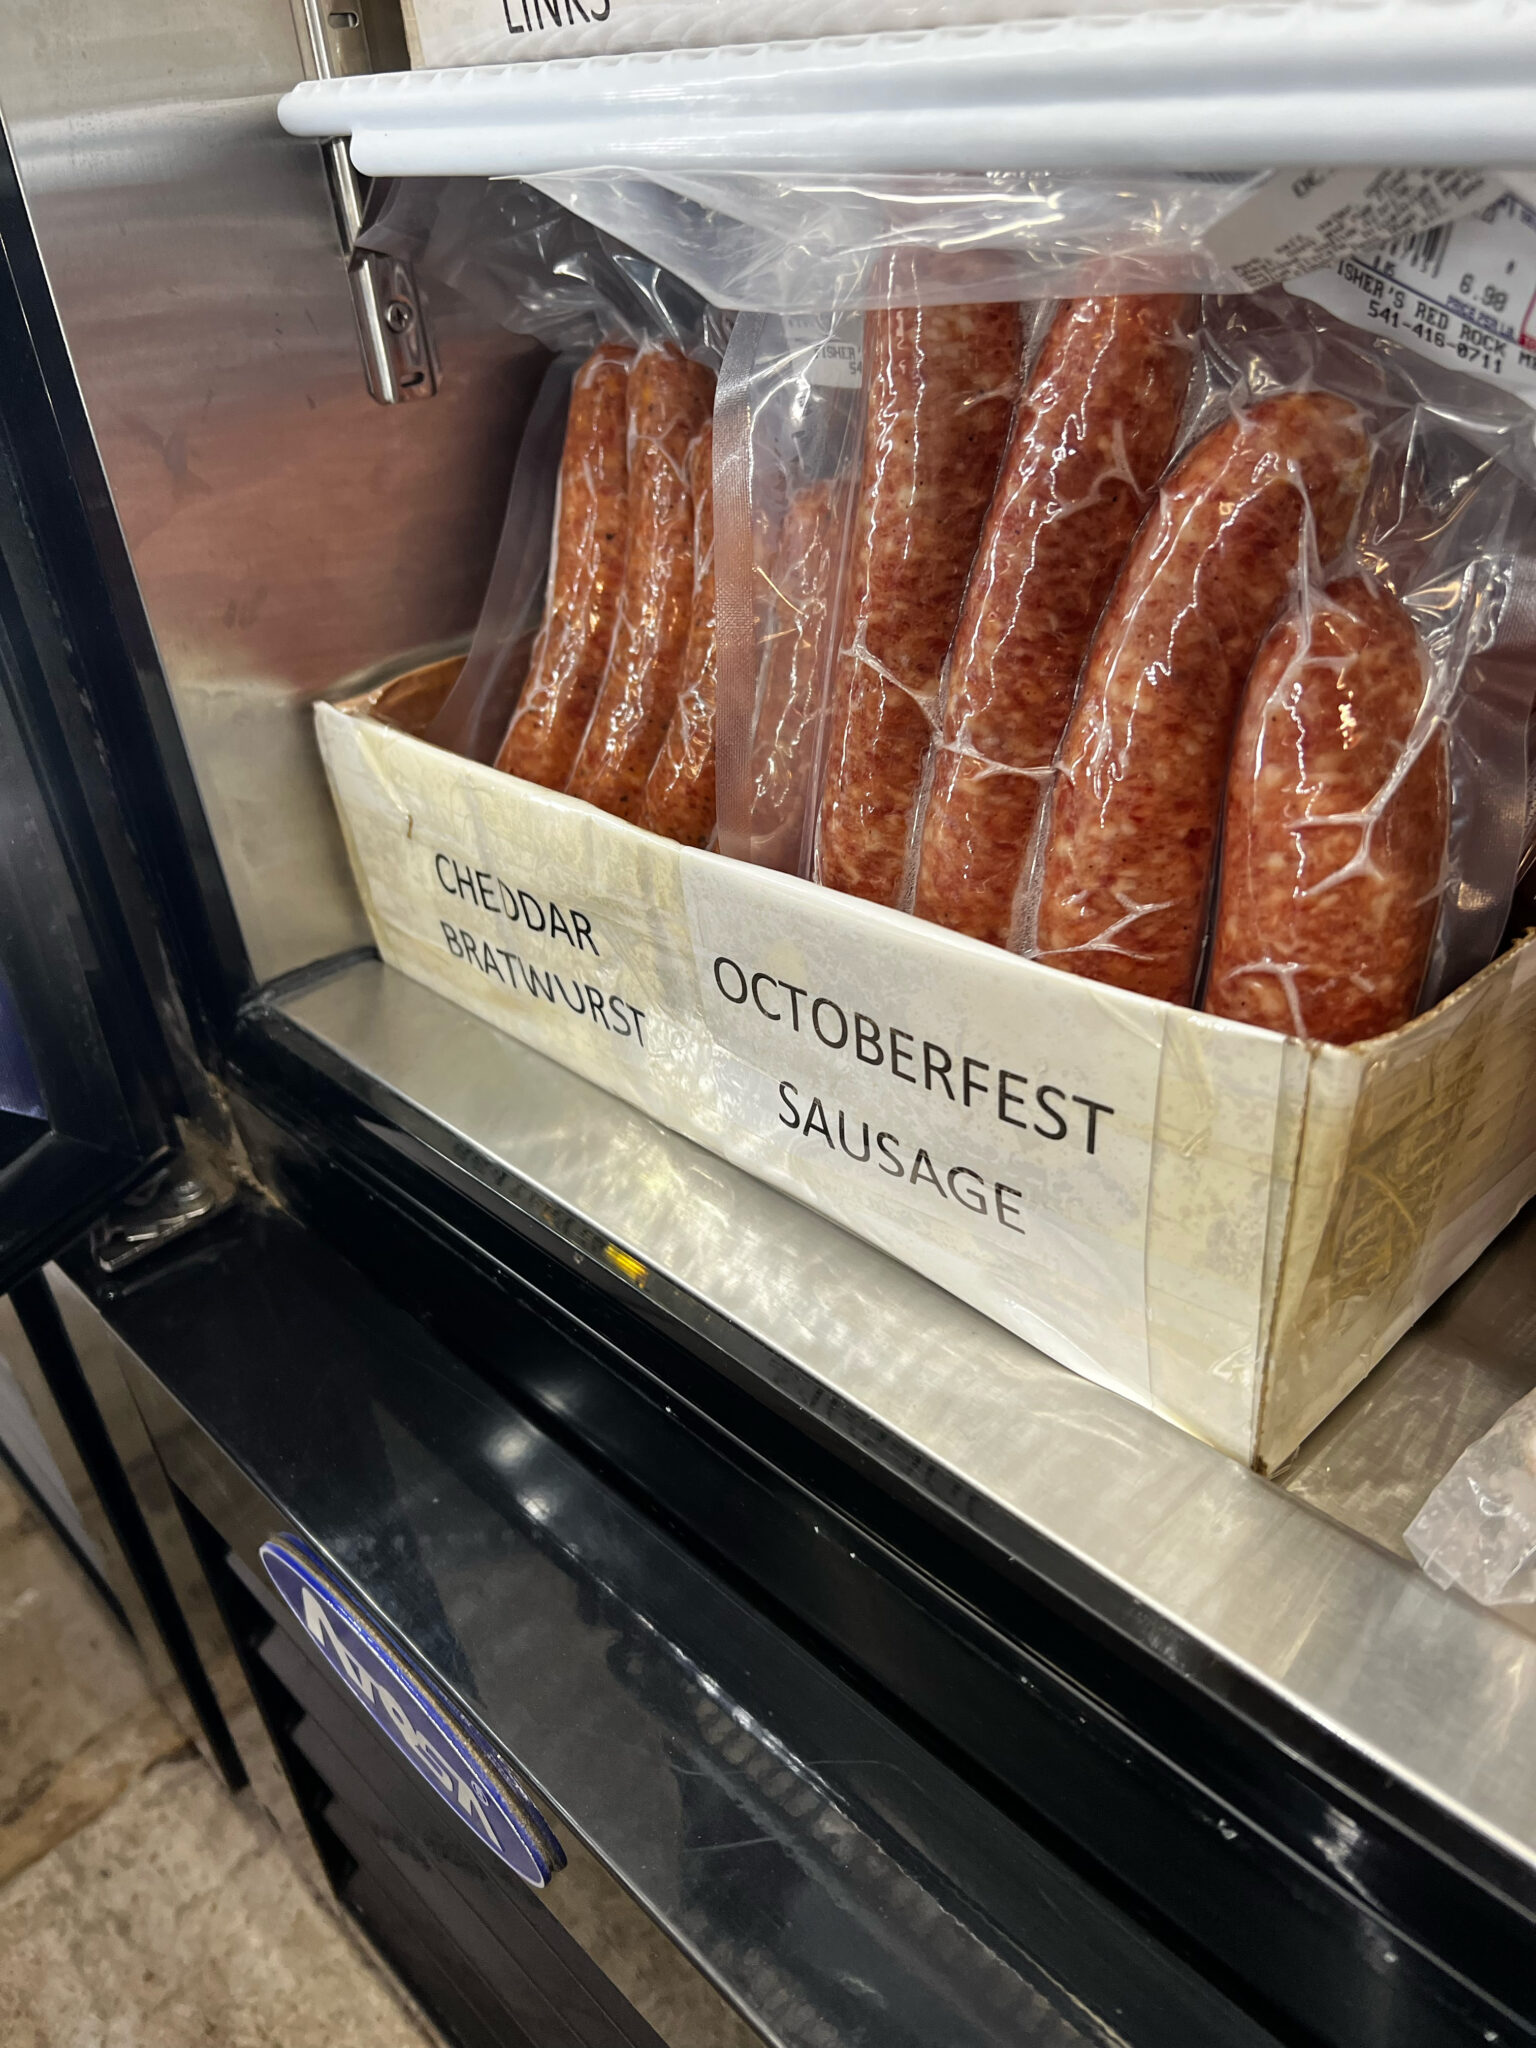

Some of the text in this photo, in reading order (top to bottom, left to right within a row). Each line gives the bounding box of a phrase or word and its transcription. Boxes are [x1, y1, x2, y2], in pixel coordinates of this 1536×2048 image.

[1337, 260, 1406, 309] ISHER'S
[1415, 301, 1449, 331] RED
[1459, 323, 1507, 358] ROCK
[1367, 300, 1502, 374] 541-416-0711
[434, 852, 600, 956] CHEDDAR
[439, 920, 646, 1048] BRATWURST
[712, 956, 1115, 1155] OCTOBERFEST
[777, 1080, 1026, 1236] SAUSAGE
